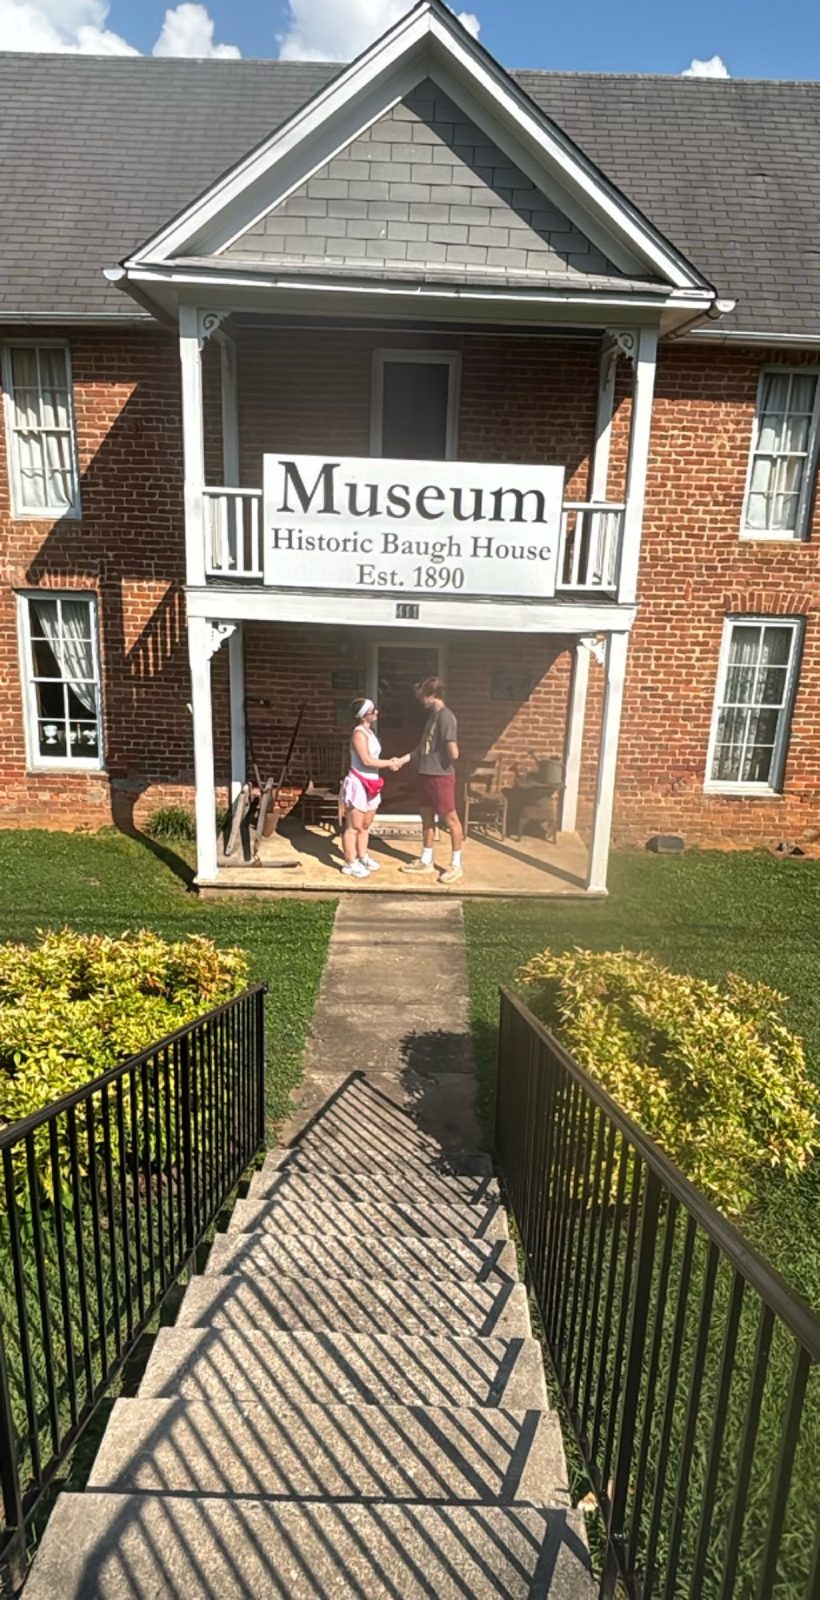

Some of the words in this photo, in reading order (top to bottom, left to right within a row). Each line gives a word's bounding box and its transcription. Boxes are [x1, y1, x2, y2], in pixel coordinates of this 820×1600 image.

[276, 460, 548, 524] Museum
[271, 527, 373, 553] Historic
[380, 532, 463, 564] Baugh
[470, 535, 551, 561] House
[356, 564, 404, 587] Est.
[412, 566, 465, 589] 1890
